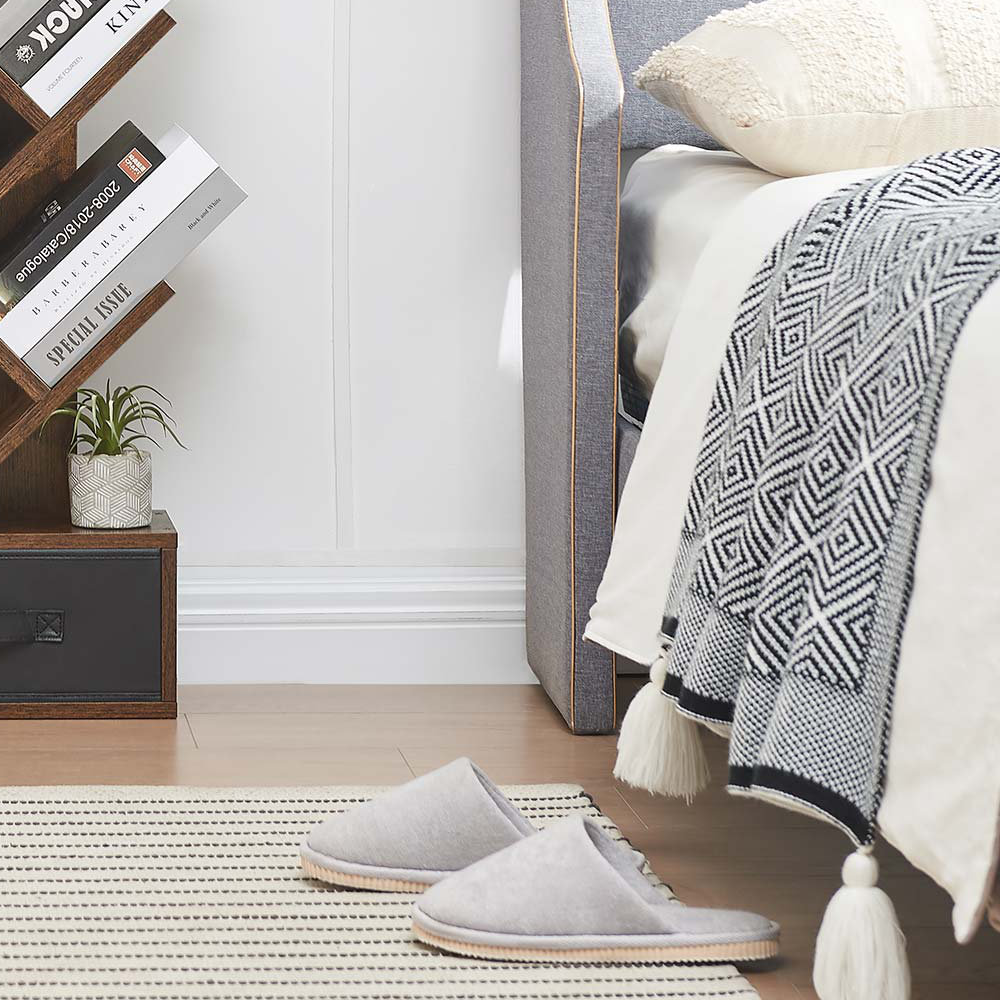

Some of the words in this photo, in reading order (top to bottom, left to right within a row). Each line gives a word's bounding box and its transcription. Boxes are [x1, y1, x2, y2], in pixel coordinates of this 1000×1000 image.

[15, 180, 120, 281] 2008-2018/Catalogue
[187, 217, 200, 229] Black
[200, 208, 209, 218] and
[207, 198, 221, 209] White
[46, 315, 98, 366] SPECIAL
[94, 282, 132, 320] ISSUE
